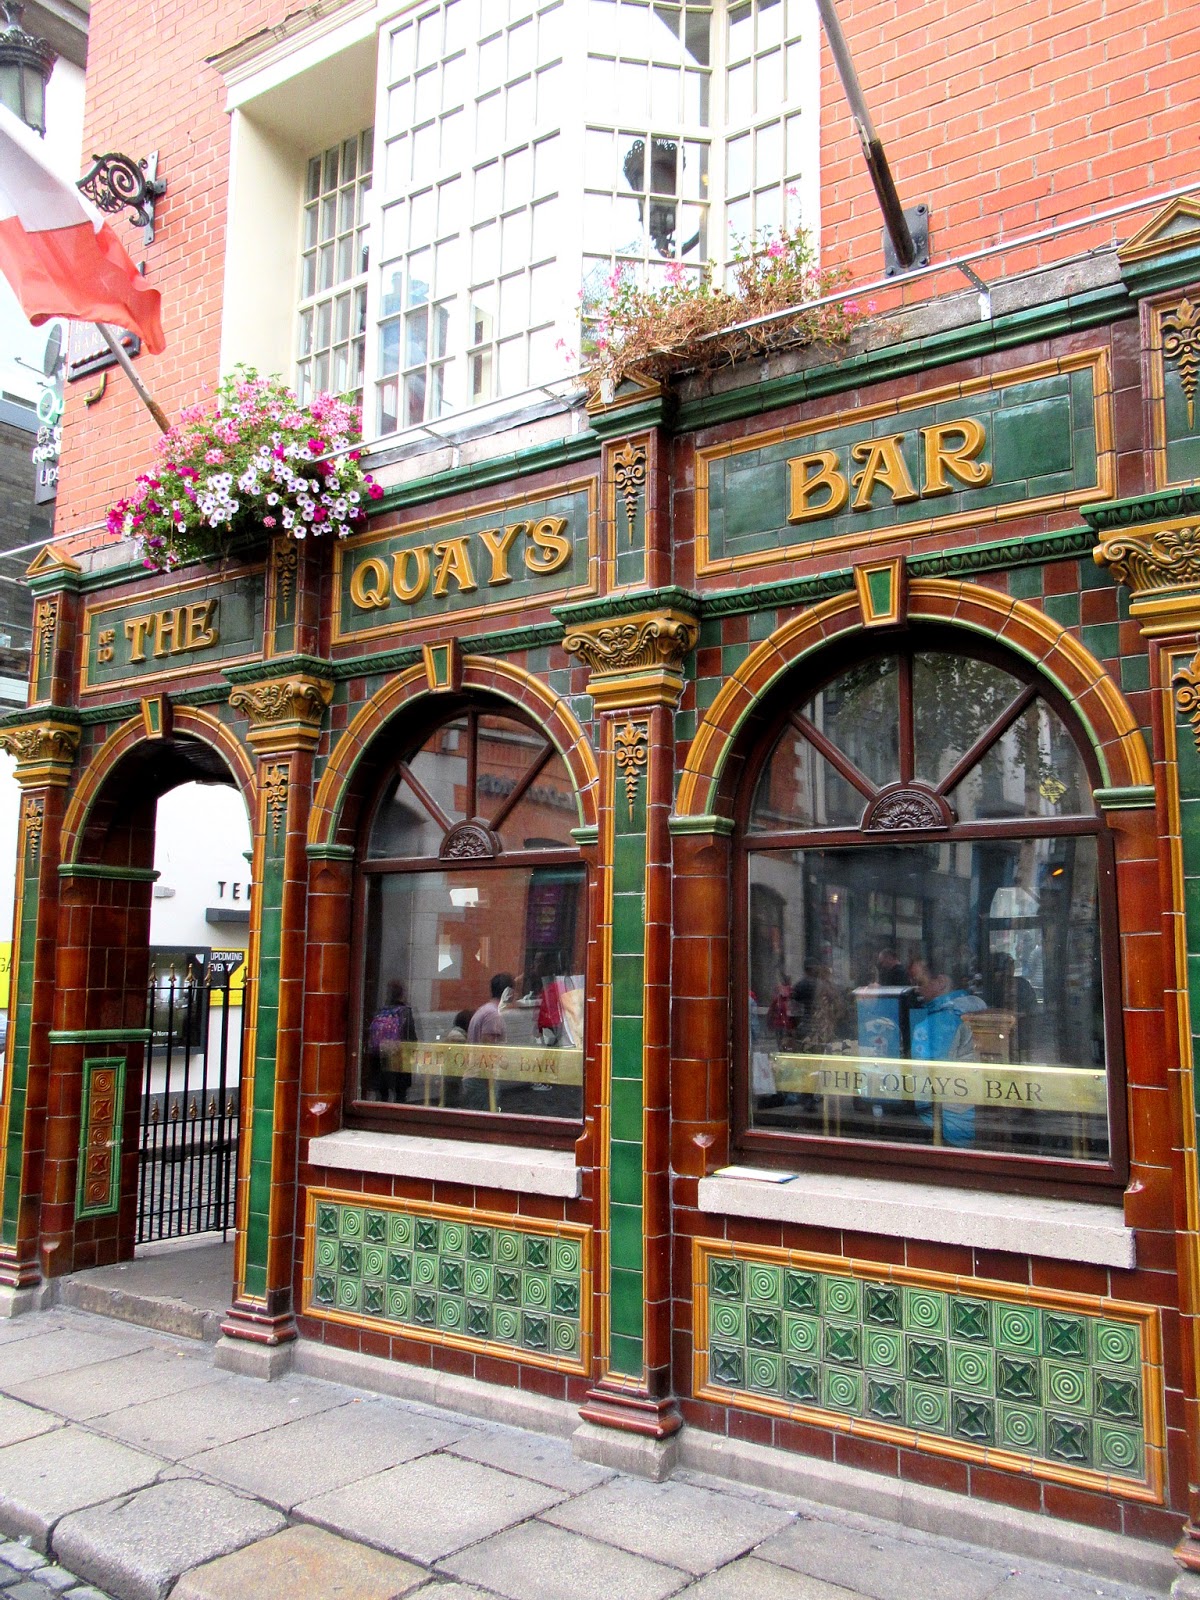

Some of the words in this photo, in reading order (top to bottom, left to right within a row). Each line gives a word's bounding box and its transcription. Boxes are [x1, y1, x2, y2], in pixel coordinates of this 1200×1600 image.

[124, 598, 218, 664] THE
[786, 418, 993, 526] BAR
[210, 952, 243, 961] UPCOMING
[519, 1056, 557, 1074] BAR
[820, 1069, 868, 1091] THE
[882, 1073, 970, 1098] QUAYS
[986, 1080, 1044, 1103] BAR
